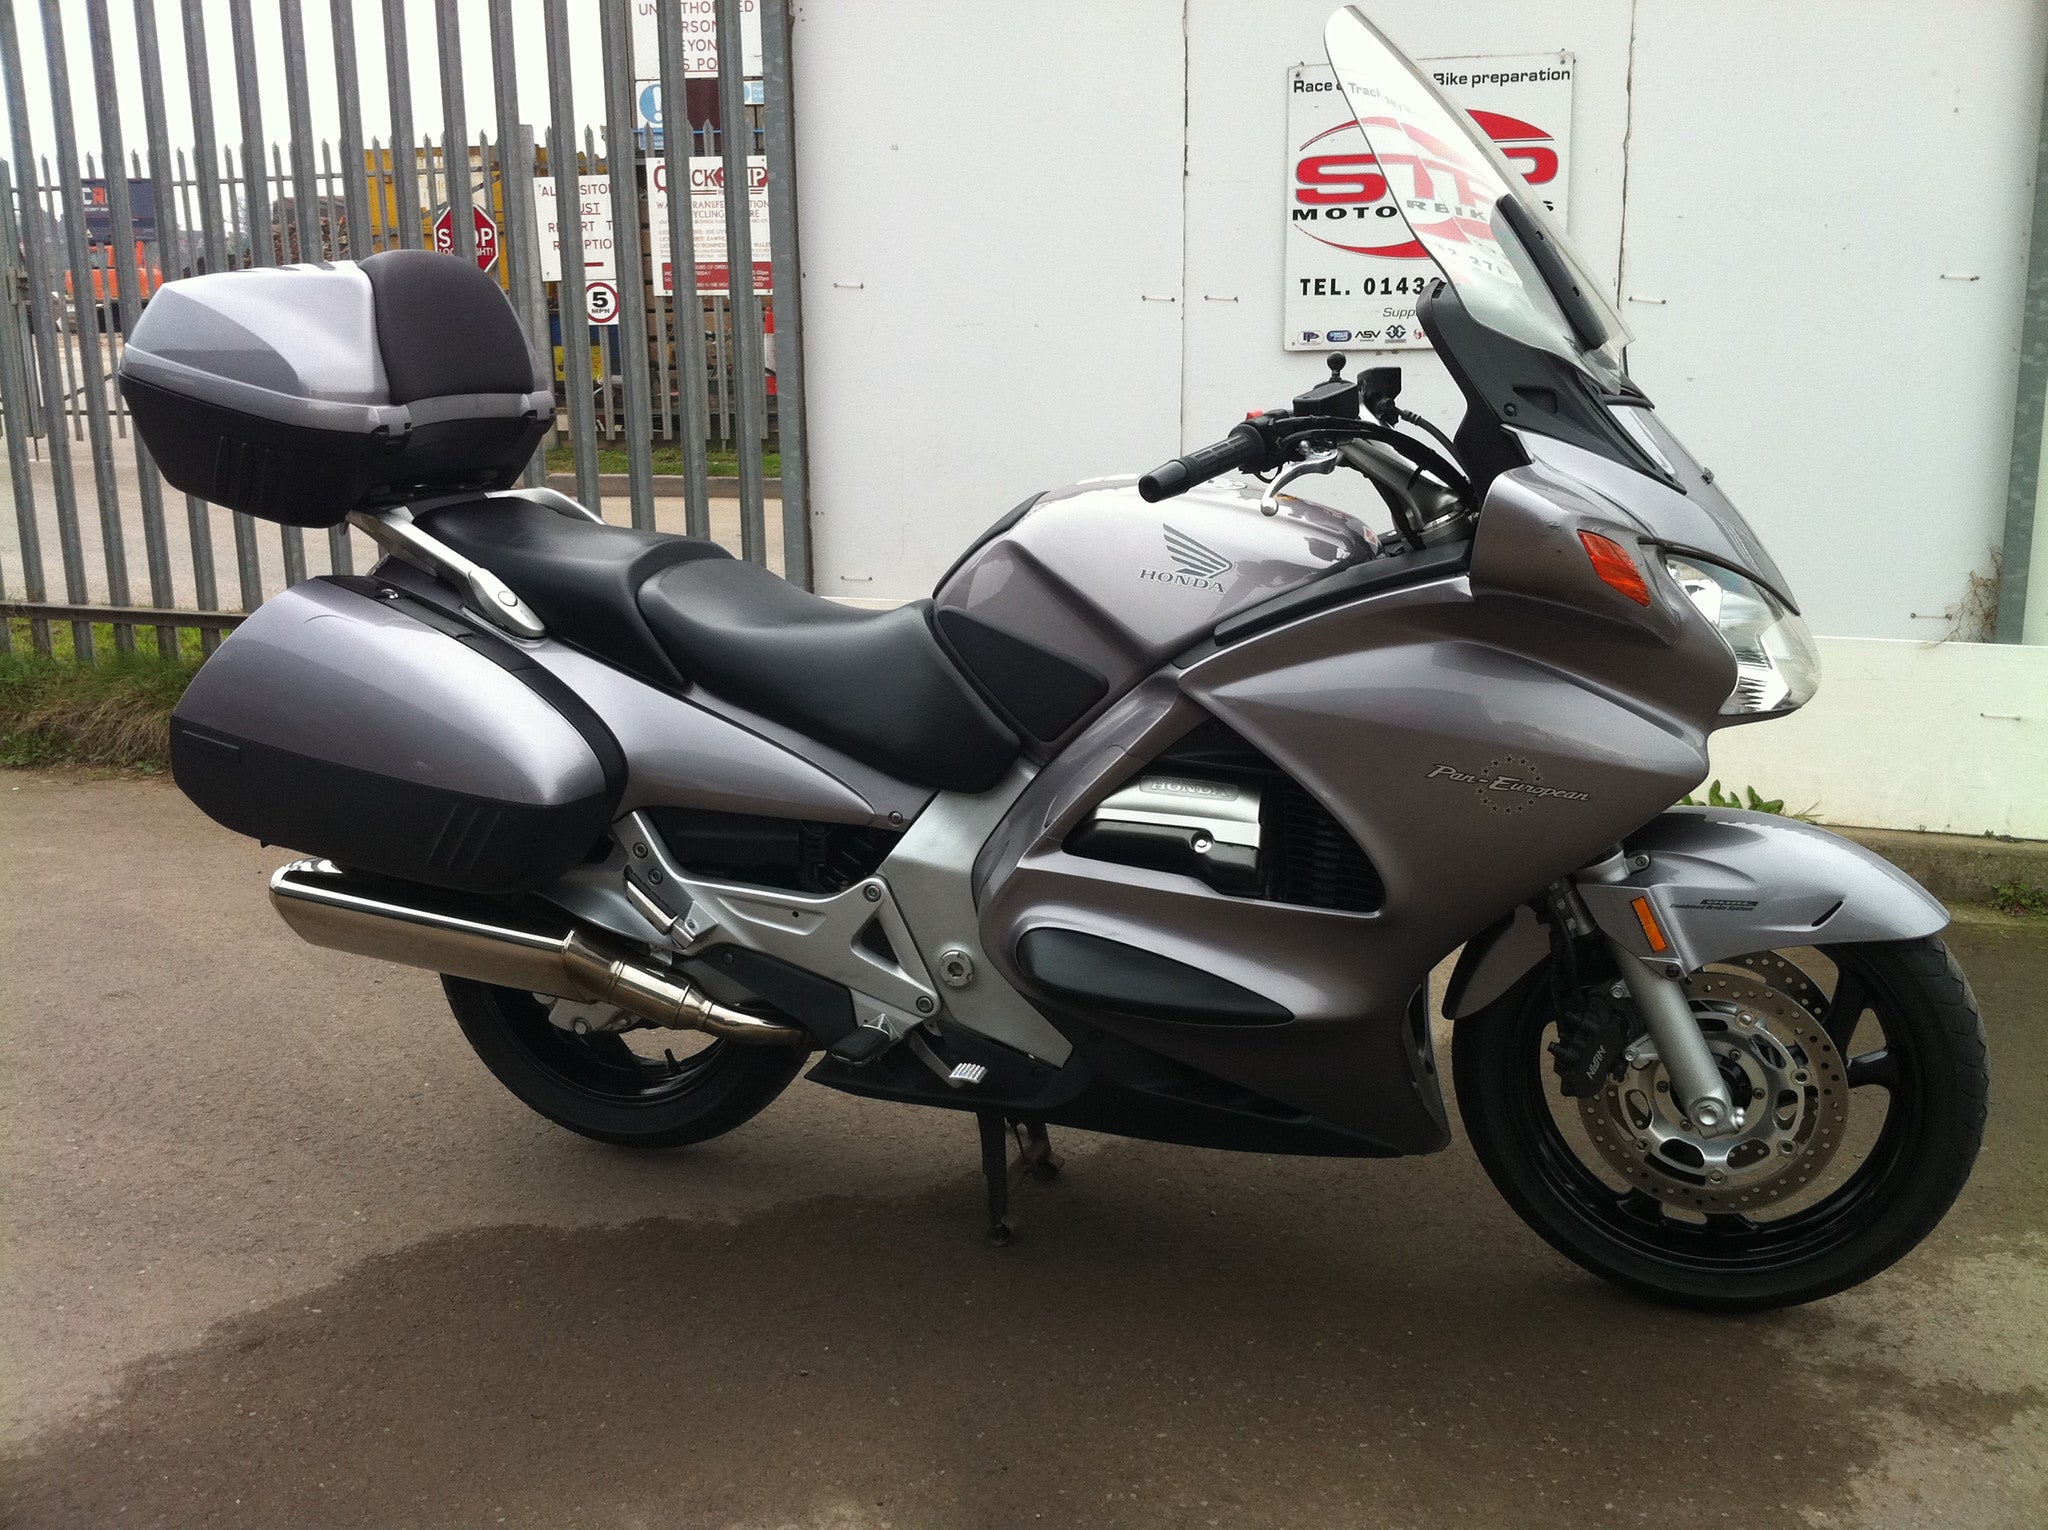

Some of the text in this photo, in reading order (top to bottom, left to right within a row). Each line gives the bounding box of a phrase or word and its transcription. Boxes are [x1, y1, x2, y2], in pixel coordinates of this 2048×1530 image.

[1294, 79, 1333, 93] Race
[1433, 67, 1571, 89] Bike preparation
[1300, 277, 1351, 297] TEL.
[592, 291, 609, 308] 5
[1140, 569, 1225, 593] HONDA
[1150, 781, 1229, 797] HONDA
[1425, 763, 1592, 801] Pan-European
